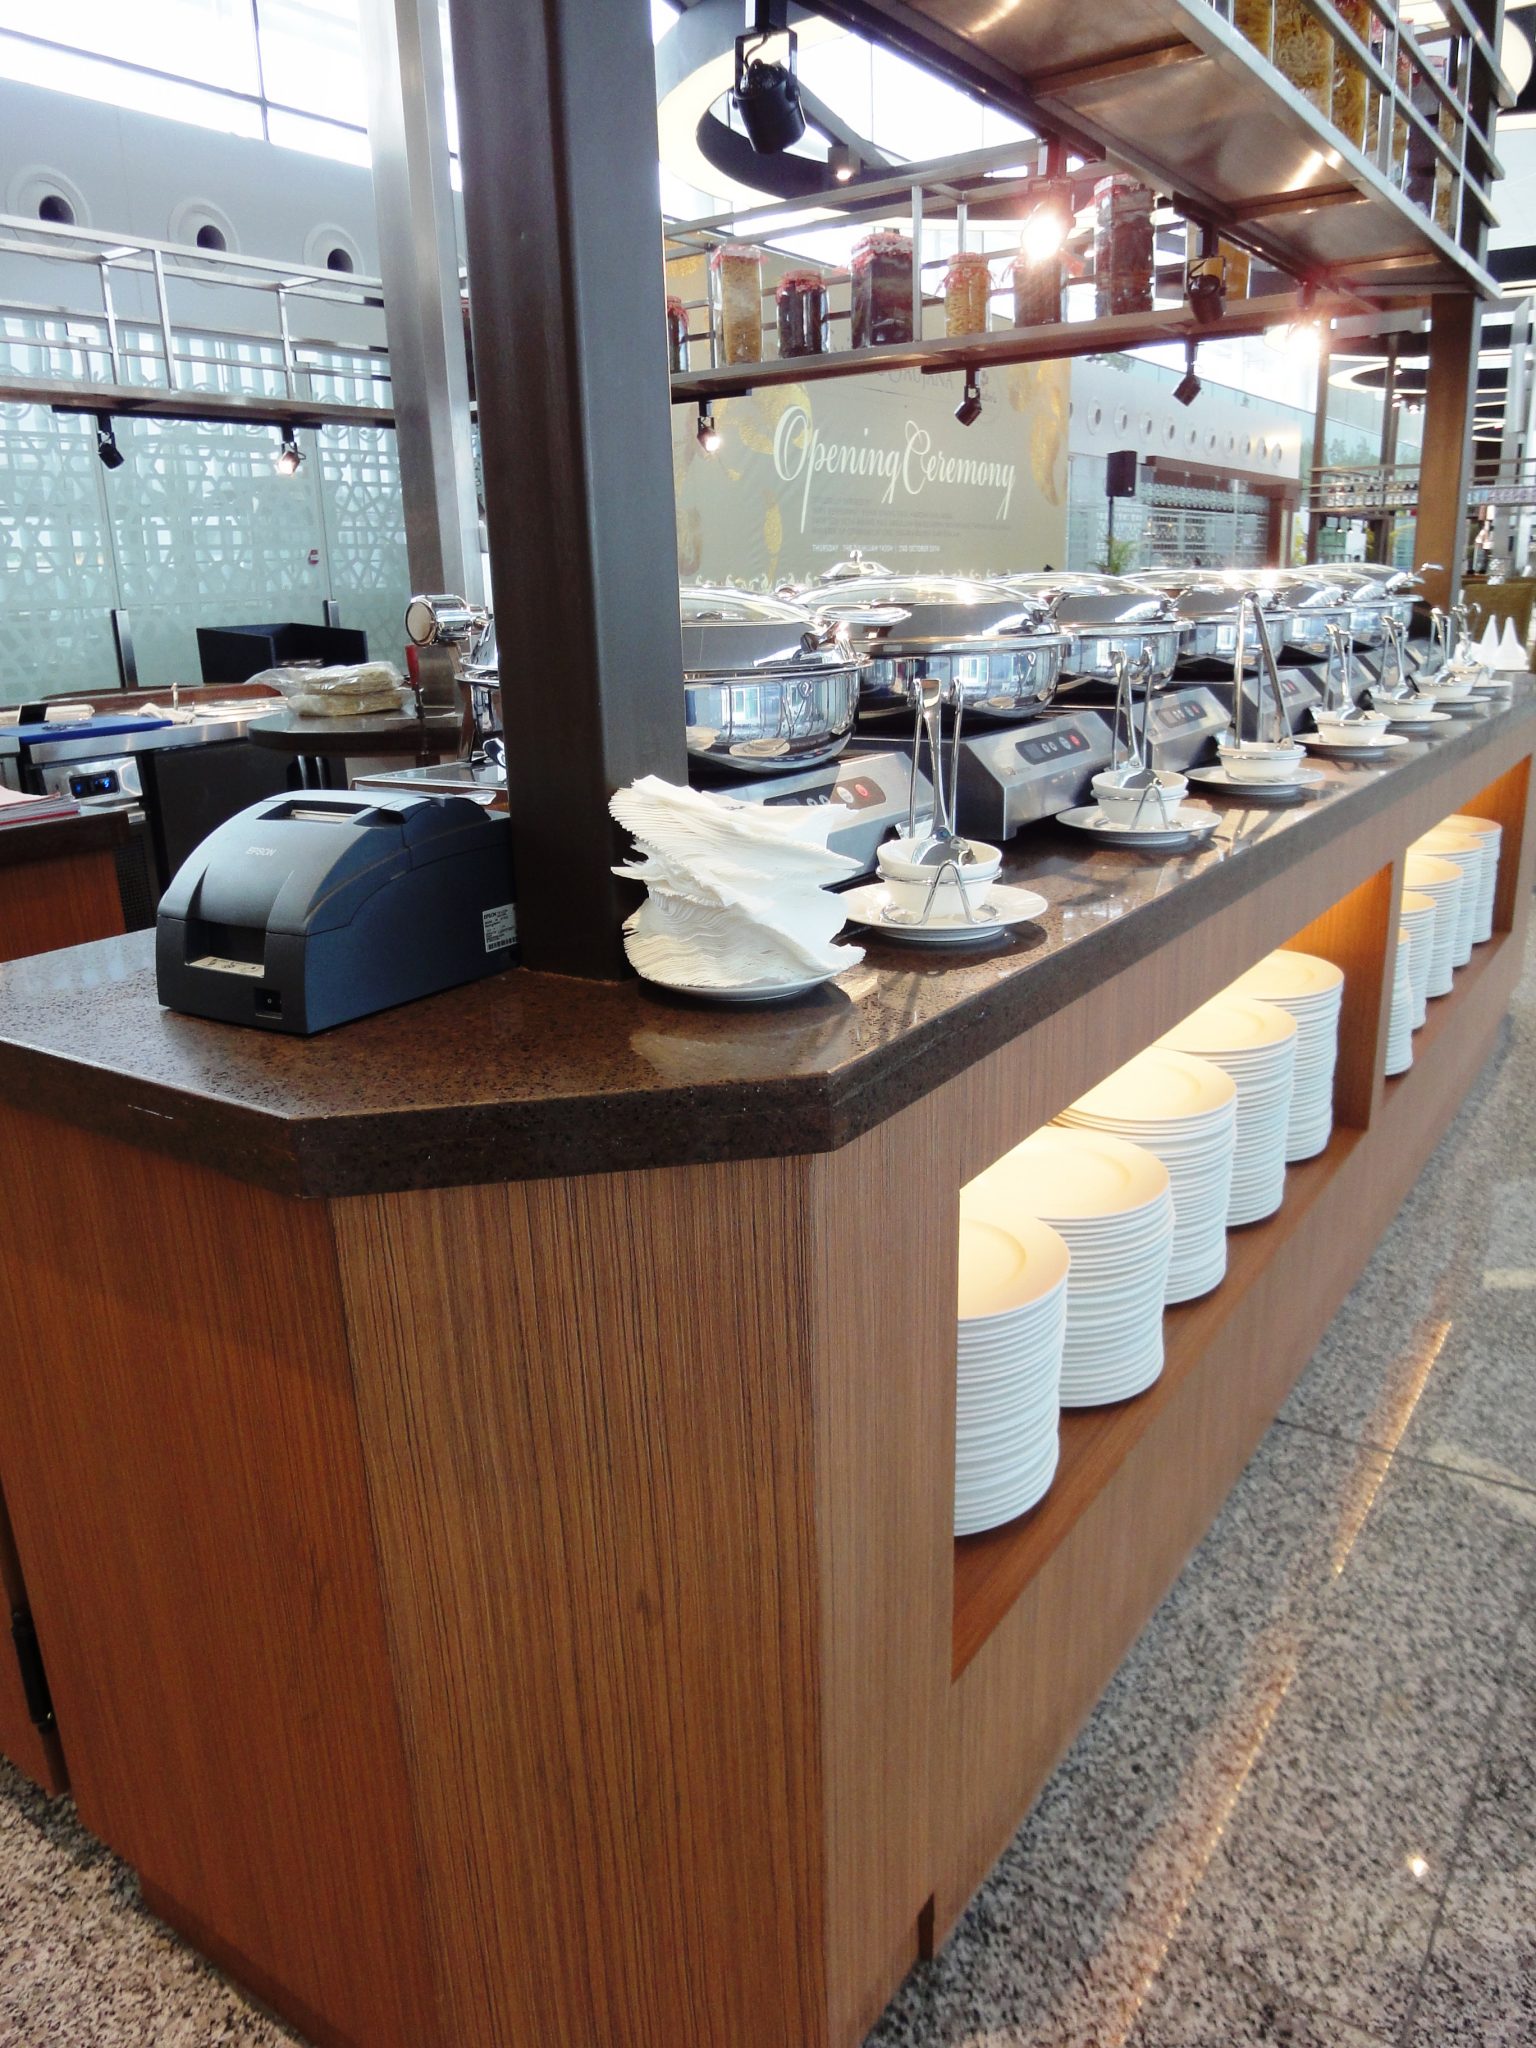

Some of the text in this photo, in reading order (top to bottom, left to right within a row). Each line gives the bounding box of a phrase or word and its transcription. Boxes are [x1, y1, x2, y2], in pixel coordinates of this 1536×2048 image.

[773, 405, 1016, 534] Opening Ceremony
[246, 846, 277, 857] EPSON
